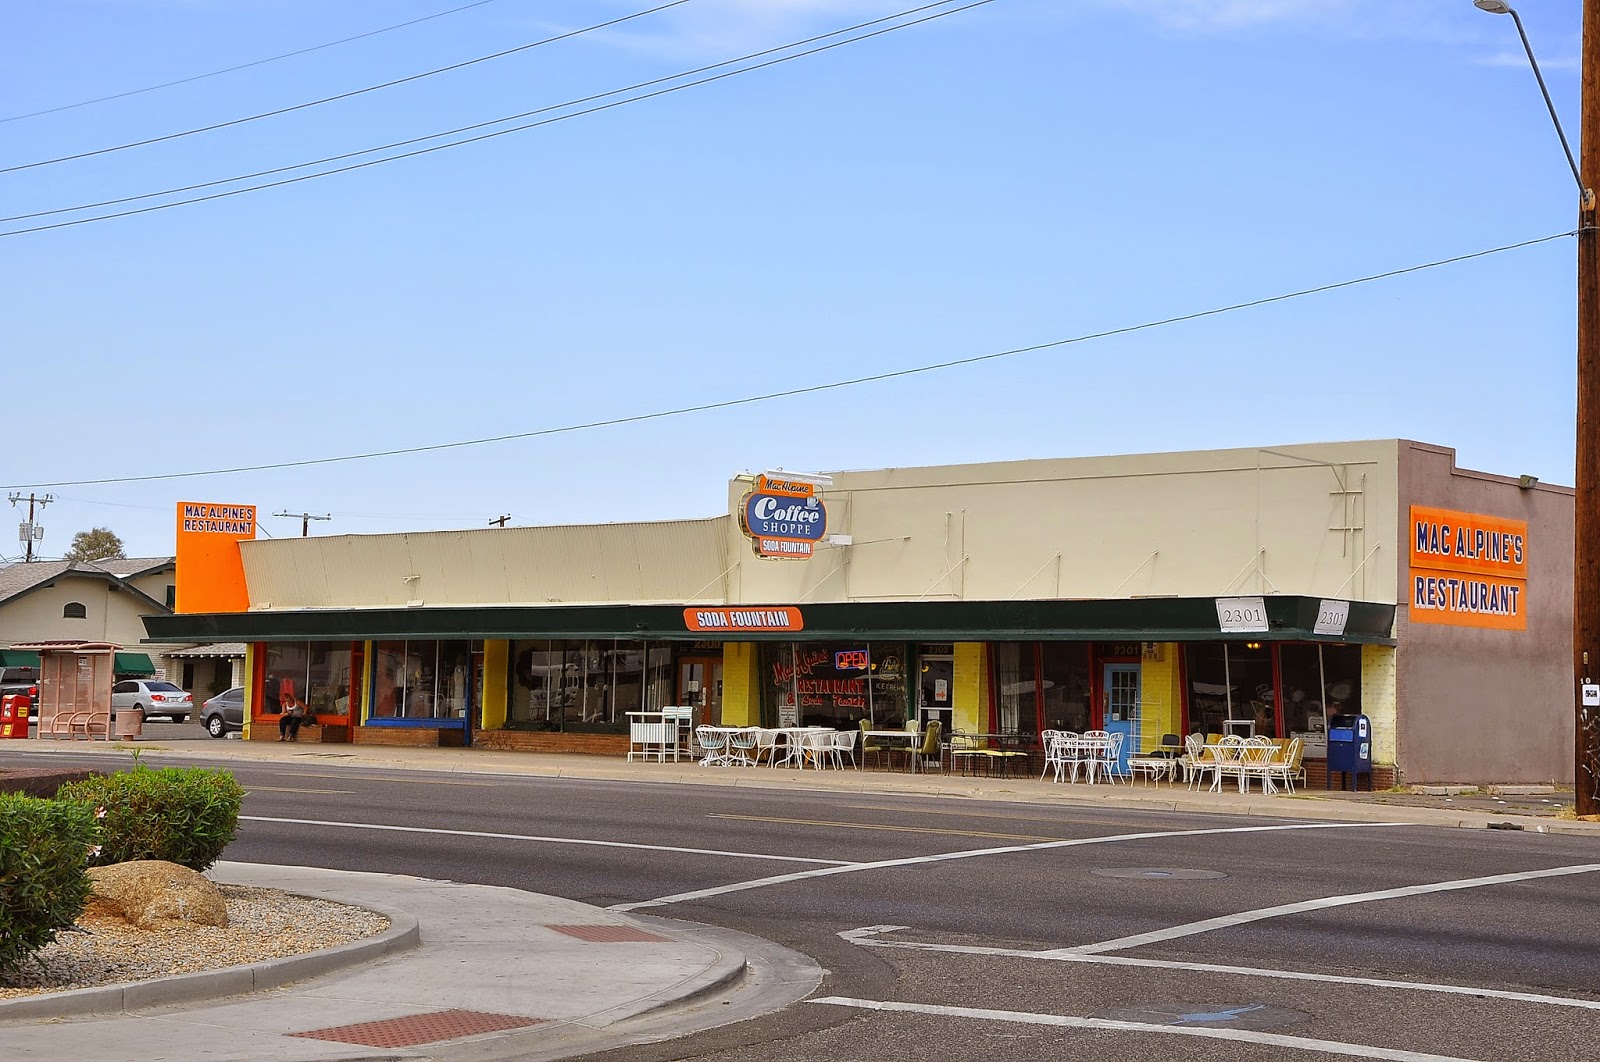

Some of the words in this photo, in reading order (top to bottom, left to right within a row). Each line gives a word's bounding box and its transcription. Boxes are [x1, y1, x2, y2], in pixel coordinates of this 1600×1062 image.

[765, 480, 781, 491] Mac
[782, 481, 809, 494] Alpine
[184, 504, 207, 518] MAC
[209, 506, 253, 520] ALPINE'S
[755, 497, 819, 523] Coffee
[184, 520, 252, 533] RESTAURANT
[763, 522, 811, 535] SHOPPE
[763, 540, 780, 552] SODA
[780, 541, 811, 554] FOUNTAIN
[1415, 521, 1451, 555] MAC
[1455, 526, 1523, 564] ALPINE'S
[1415, 576, 1520, 616] RESTAURANT
[696, 611, 729, 627] SODA
[730, 610, 790, 627] FOUNTAIN
[1223, 608, 1263, 623] 2301
[1320, 611, 1345, 626] 2301
[928, 645, 949, 654] 2303
[1113, 646, 1138, 656] 2301
[837, 652, 868, 668] OPEN
[798, 679, 865, 695] RESTAURANT
